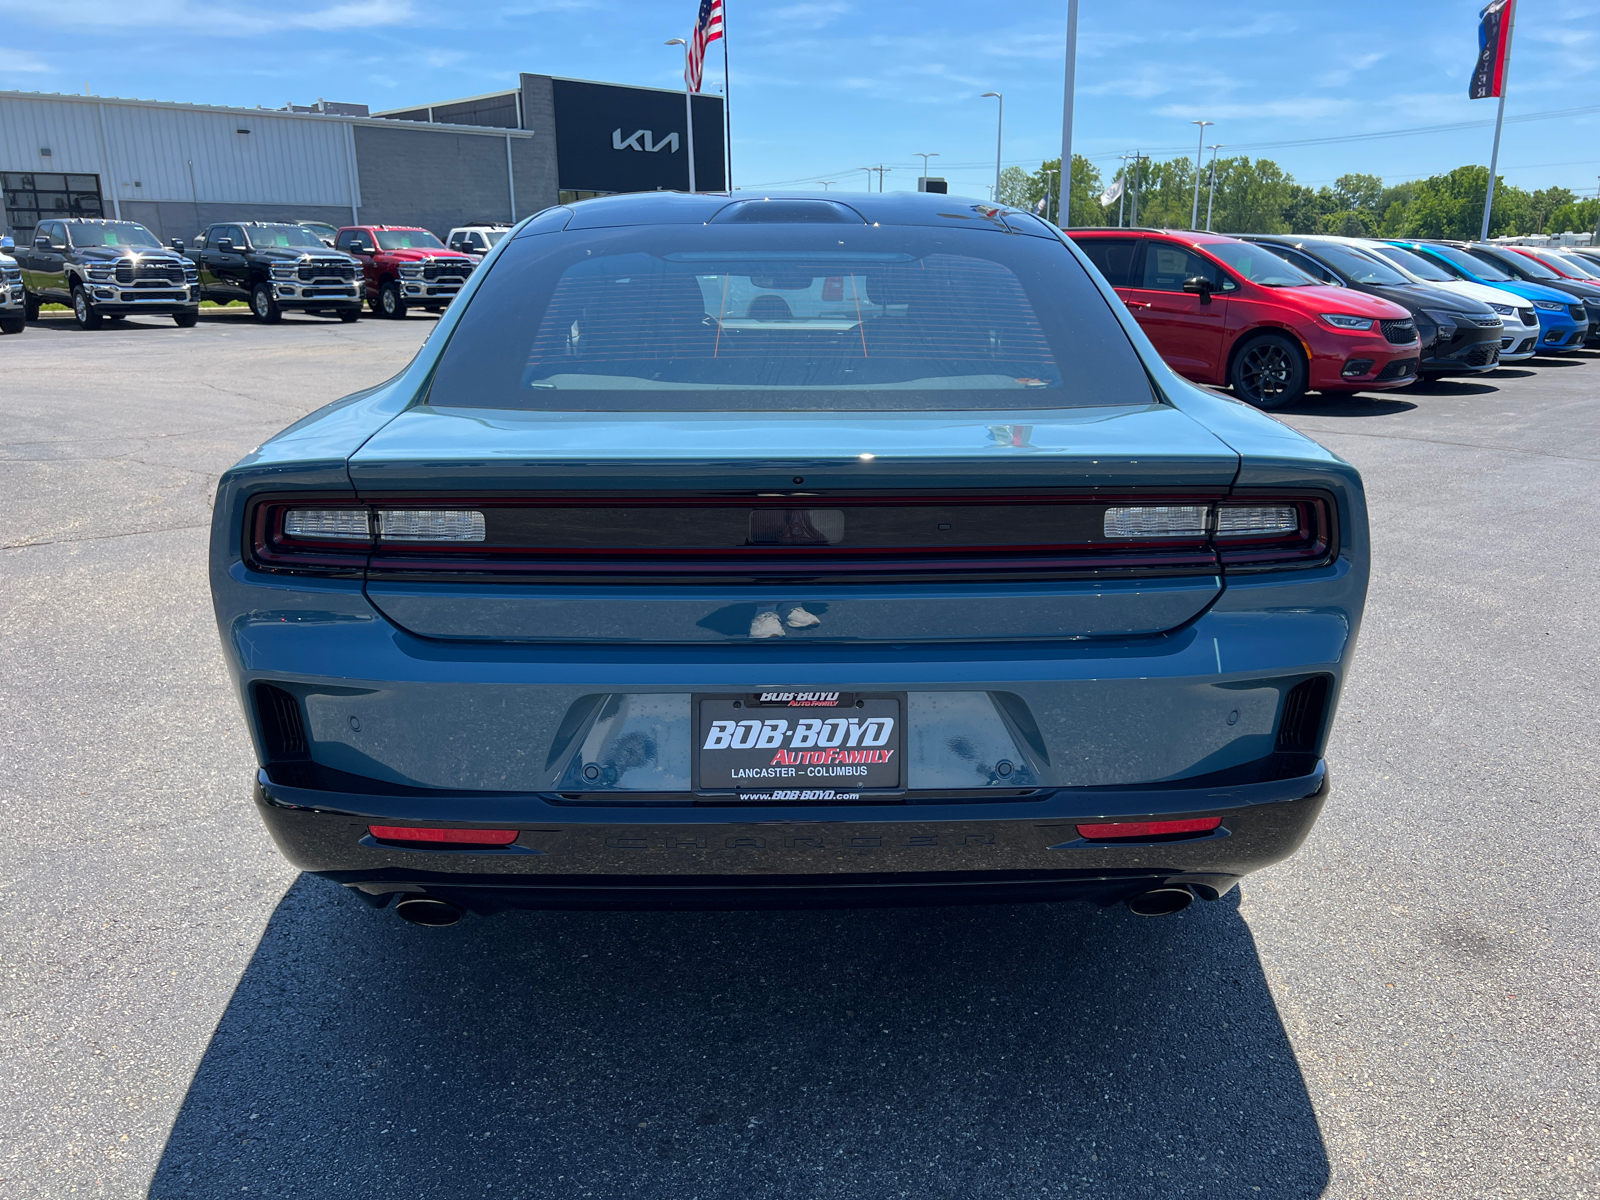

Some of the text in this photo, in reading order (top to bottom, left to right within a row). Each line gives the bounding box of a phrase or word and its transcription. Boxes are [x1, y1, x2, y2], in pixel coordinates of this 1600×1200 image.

[612, 127, 680, 154] KIA
[731, 768, 796, 779] LANCASTER
[807, 766, 868, 777] COLUMBUS
[605, 834, 997, 849] CHARGER
